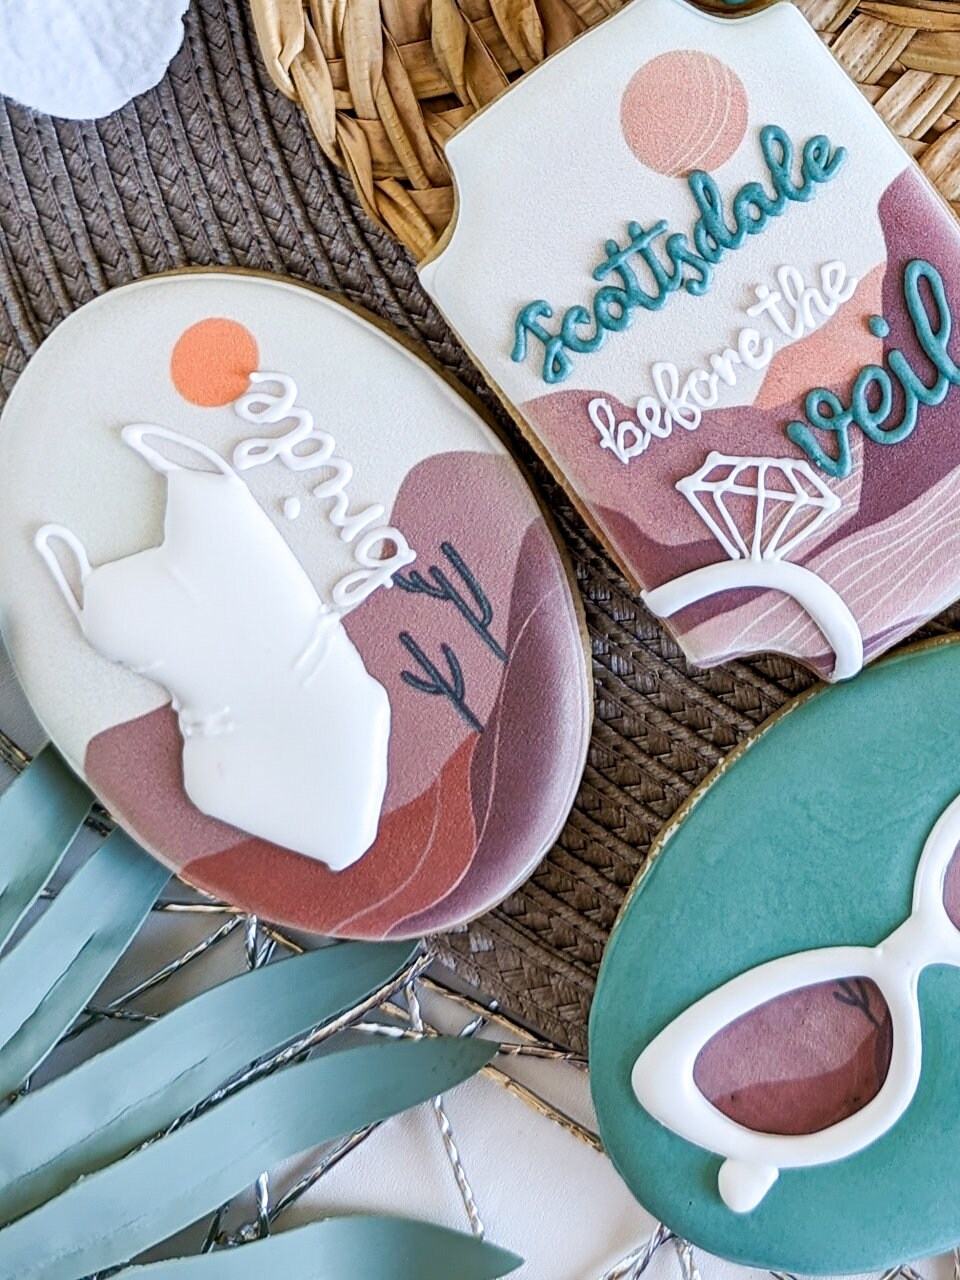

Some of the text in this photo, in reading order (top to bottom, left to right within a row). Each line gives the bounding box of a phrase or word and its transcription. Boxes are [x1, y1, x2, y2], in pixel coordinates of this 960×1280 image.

[586, 258, 858, 464] before the
[233, 370, 416, 608] bride
